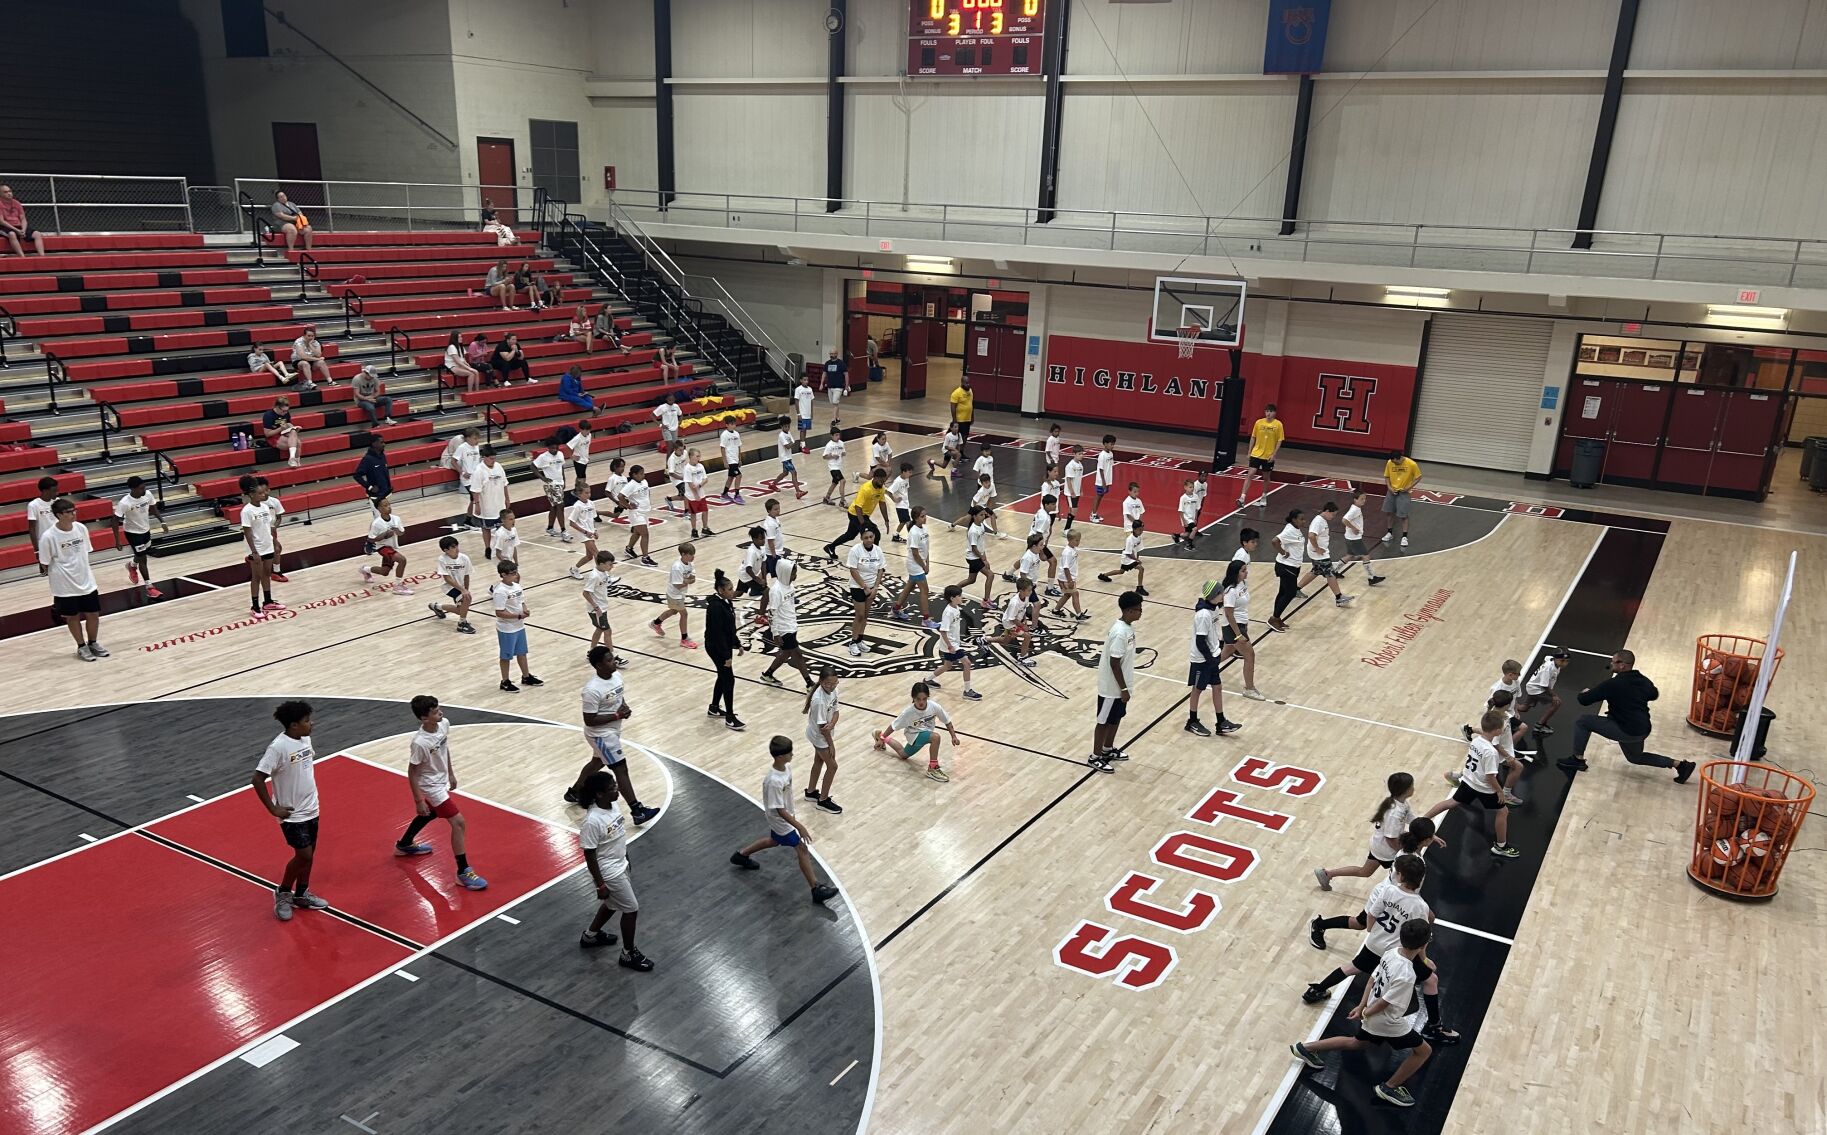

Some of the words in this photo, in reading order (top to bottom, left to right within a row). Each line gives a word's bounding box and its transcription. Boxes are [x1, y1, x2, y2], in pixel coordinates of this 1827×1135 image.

[948, 13, 960, 35] 3
[976, 10, 981, 30] 1
[991, 12, 1003, 34] 3
[1741, 291, 1757, 302] EXIT
[1312, 373, 1378, 435] H
[1361, 641, 1405, 669] Robert
[1465, 754, 1479, 773] 25
[1052, 755, 1327, 992] SCOTS
[1376, 910, 1400, 934] 25
